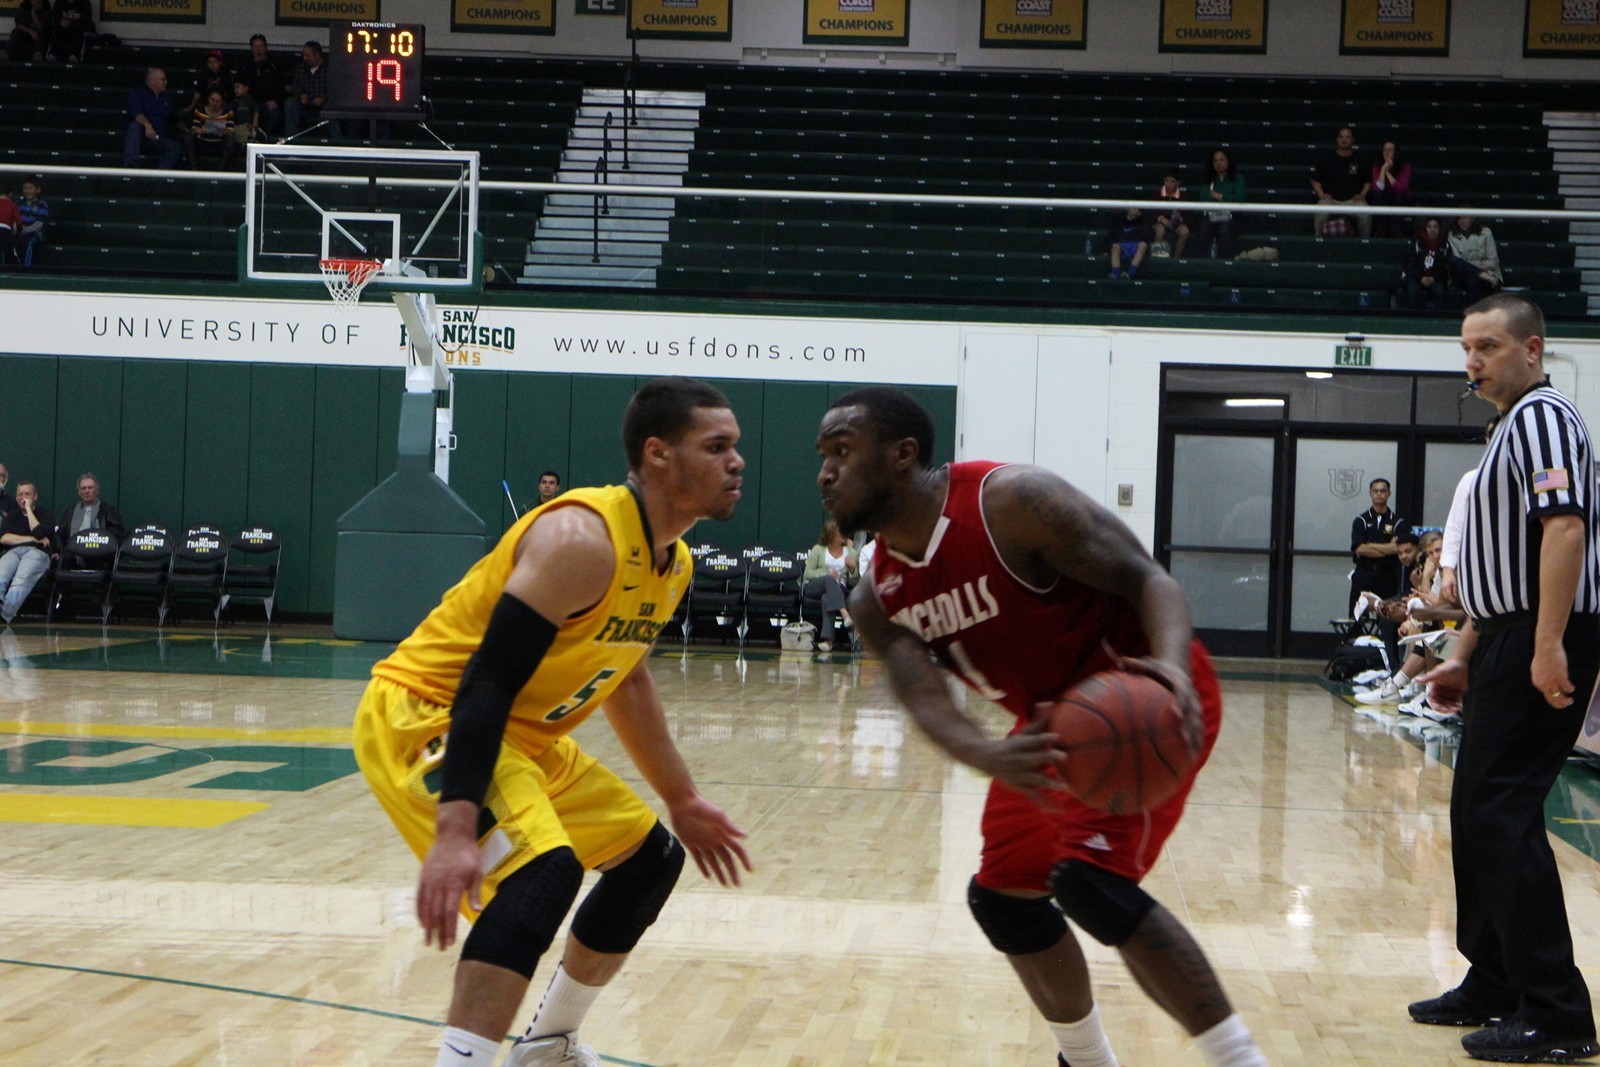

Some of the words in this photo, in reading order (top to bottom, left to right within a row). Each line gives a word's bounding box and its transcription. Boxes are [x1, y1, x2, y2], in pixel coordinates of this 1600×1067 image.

[116, 0, 191, 9] CHAMPIONS
[291, 1, 366, 14] CHAMPIONS
[466, 8, 542, 20] CHAMPIONS
[643, 14, 718, 26] CHAMPIONS
[351, 21, 396, 29] DAKTRONICS
[819, 18, 894, 31] CHAMPIONS
[996, 22, 1072, 35] CHAMPIONS
[1175, 27, 1252, 40] CHAMPIONS
[1356, 30, 1434, 42] CHAMPIONS
[347, 31, 413, 57] 17:10
[367, 60, 401, 101] 19
[443, 310, 474, 322] SAN
[92, 315, 300, 344] UNIVERSITY
[321, 323, 361, 345] OF
[554, 336, 867, 363] www.usfdons.com
[1341, 347, 1367, 365] EXIT
[76, 535, 109, 545] FRANCISCO
[131, 537, 164, 547] FRANCISCO
[241, 531, 273, 541] FRANCISCO
[187, 540, 219, 549] FRANCISCO
[705, 557, 738, 567] FRANCISCO
[760, 559, 793, 569] FRANCISCO
[543, 668, 619, 722] 5
